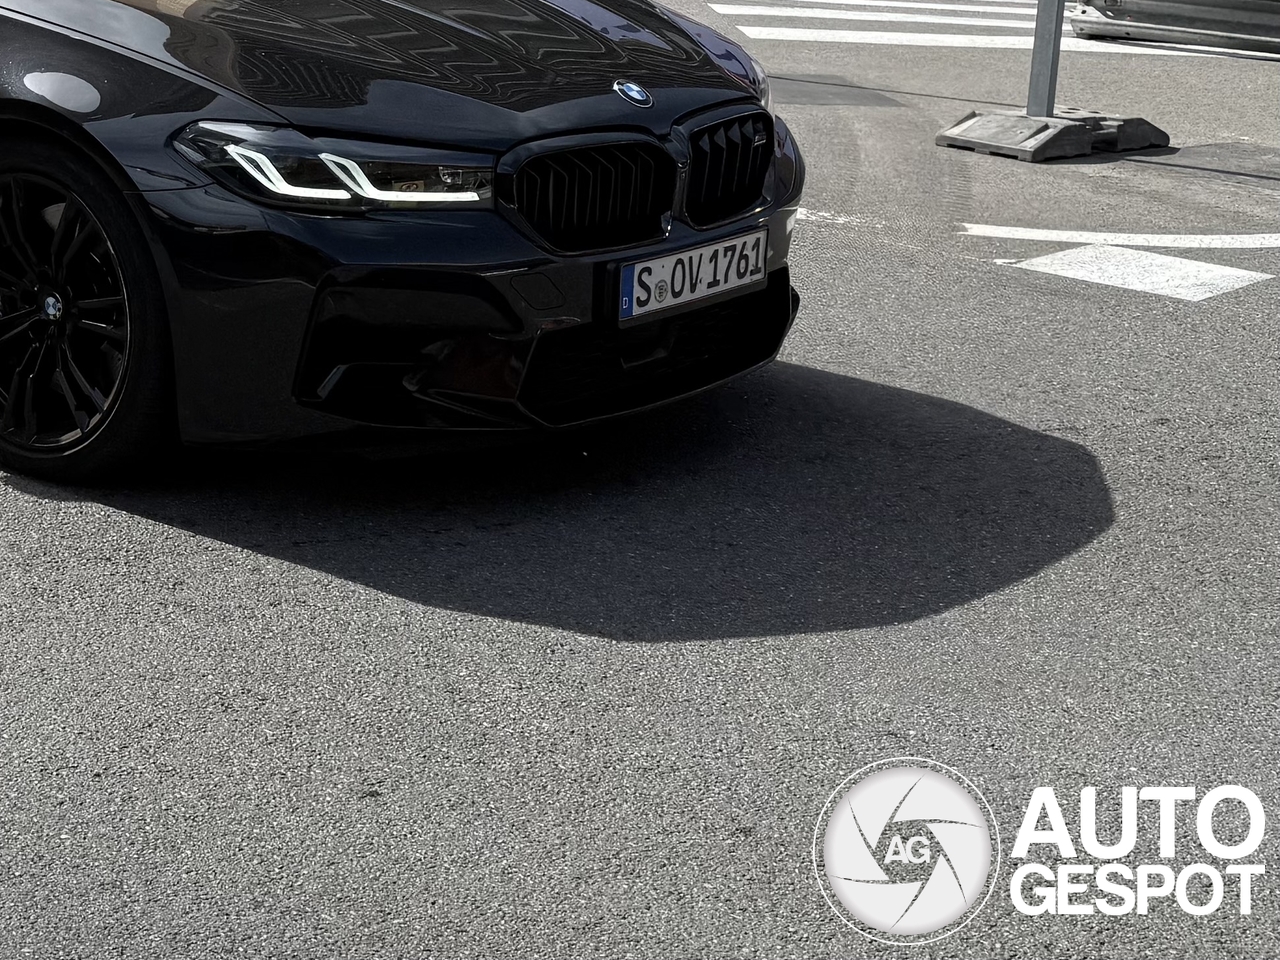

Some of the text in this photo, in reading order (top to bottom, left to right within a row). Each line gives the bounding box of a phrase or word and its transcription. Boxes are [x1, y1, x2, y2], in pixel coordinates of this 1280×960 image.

[636, 236, 763, 308] S OV 1761
[622, 297, 629, 309] D
